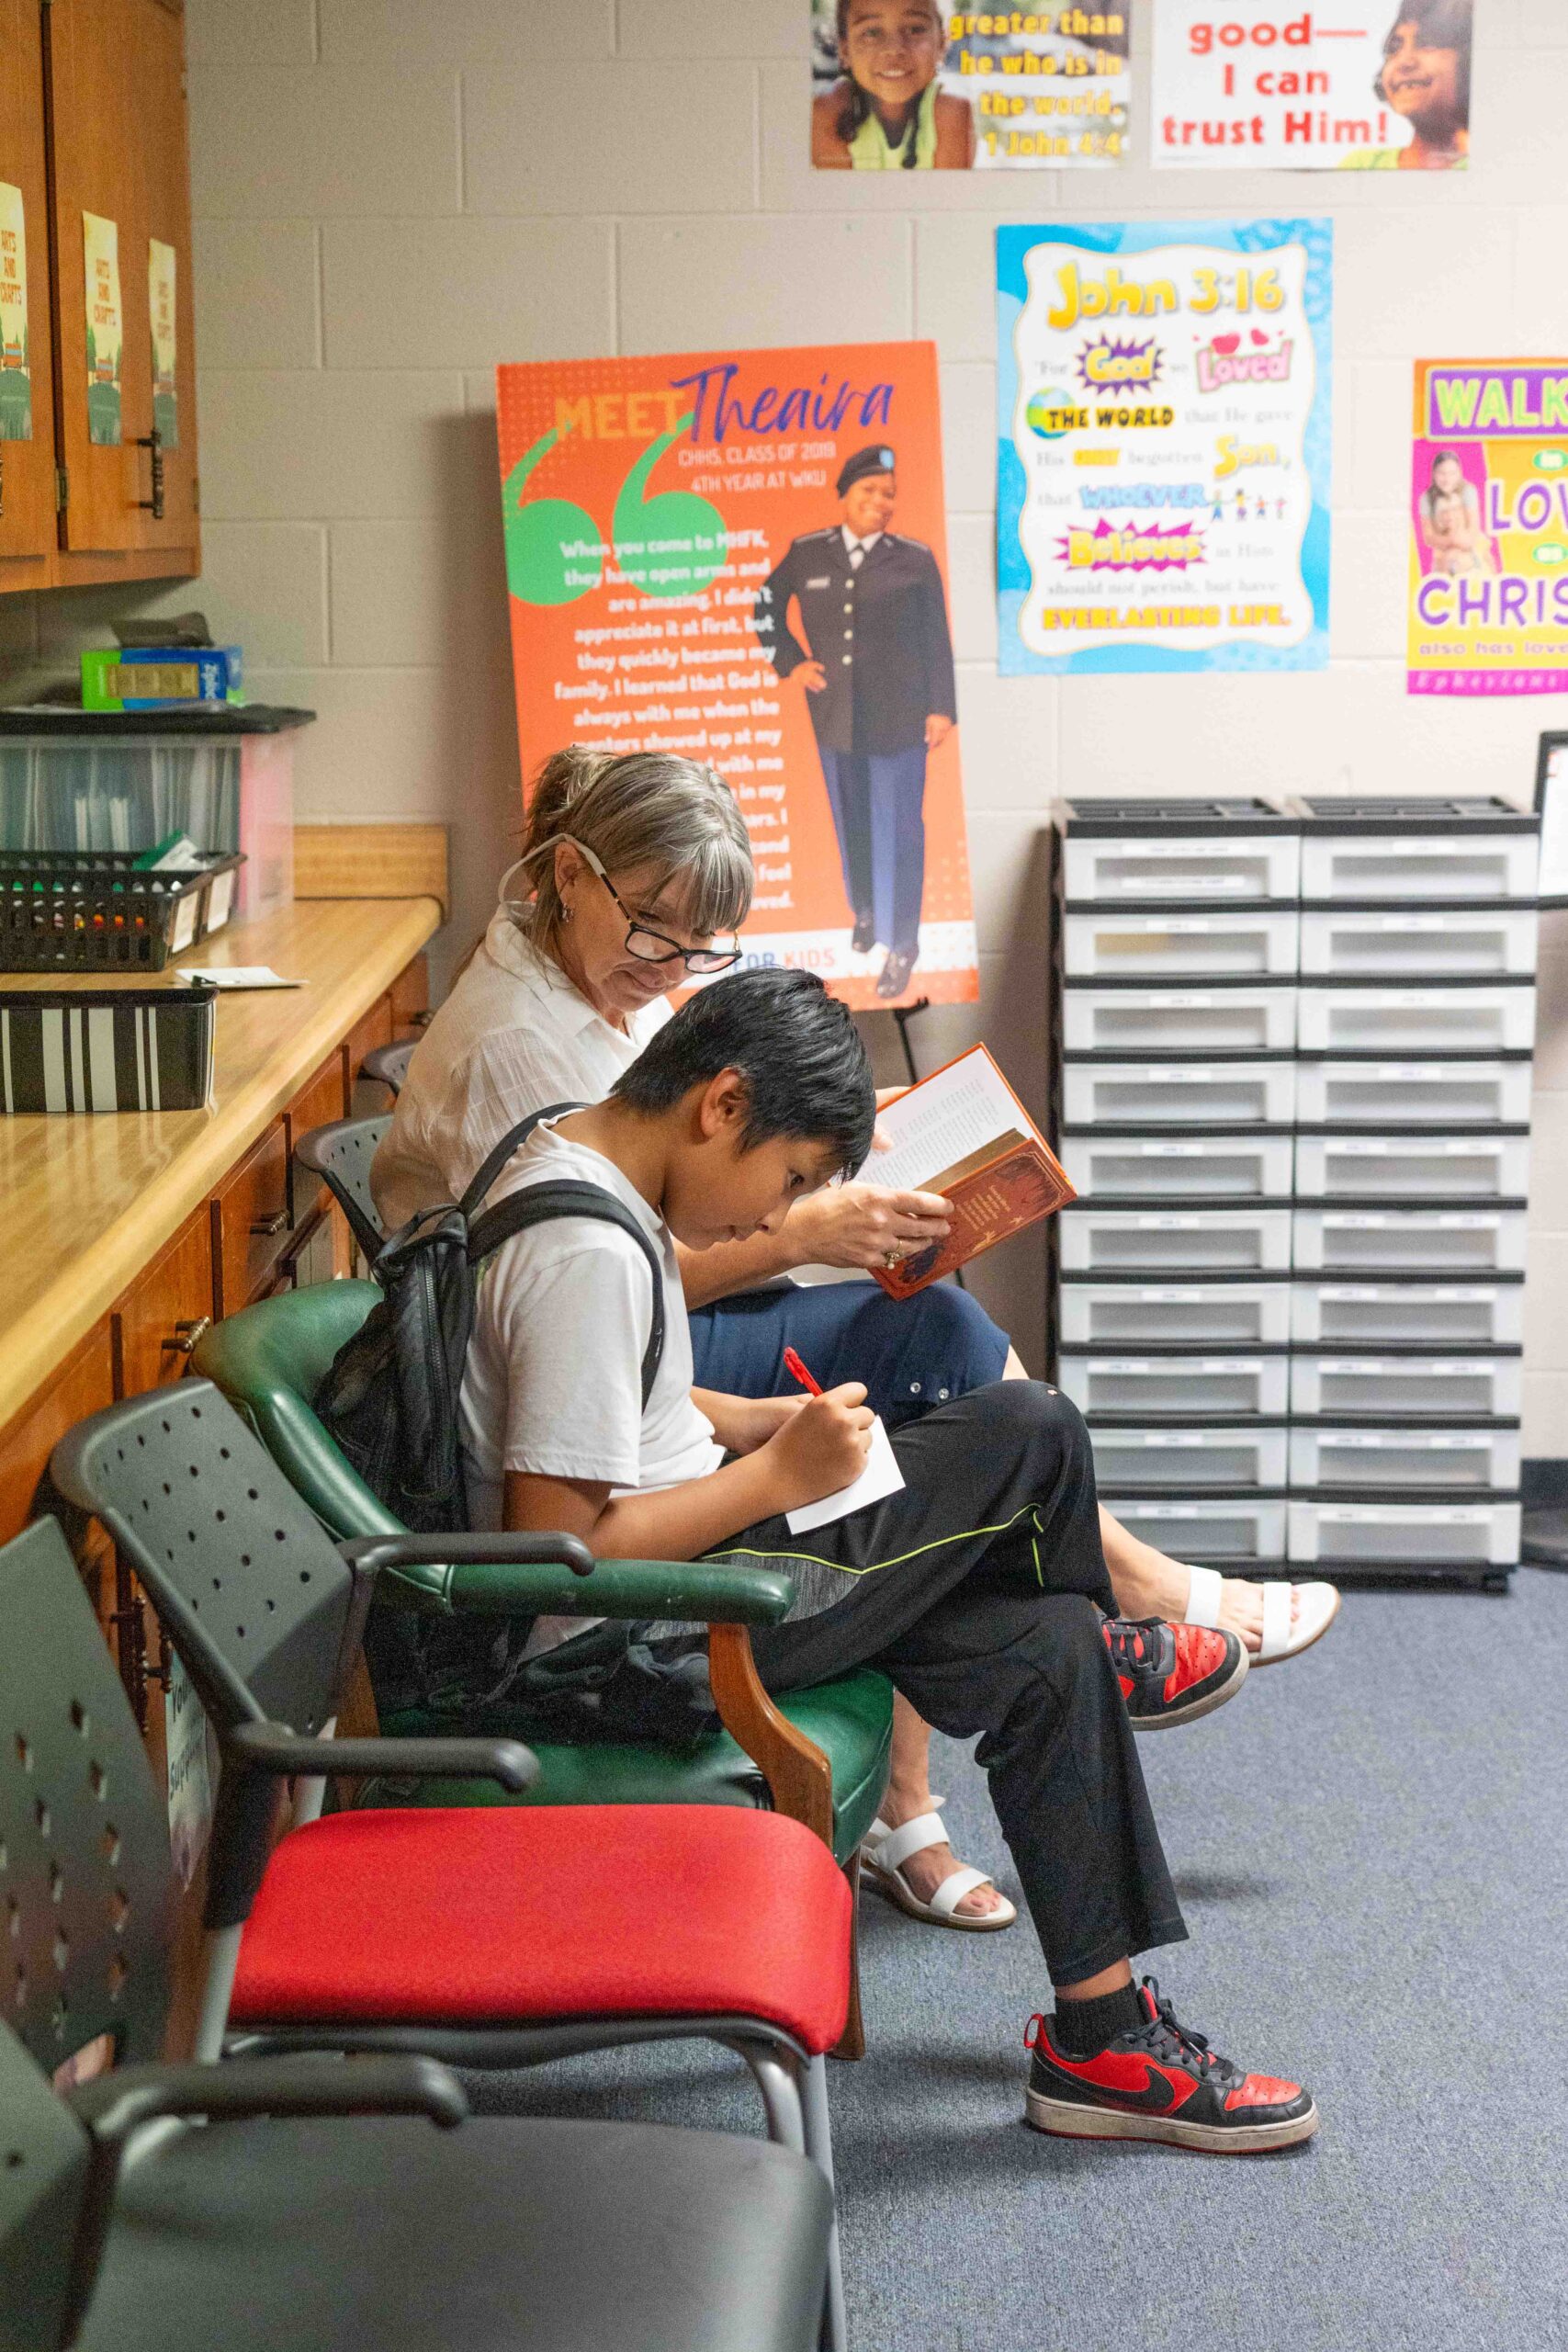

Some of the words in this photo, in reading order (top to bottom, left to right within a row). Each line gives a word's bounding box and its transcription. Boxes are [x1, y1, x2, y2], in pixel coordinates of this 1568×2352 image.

[948, 11, 1052, 40] greater
[1060, 9, 1123, 35] than
[960, 50, 992, 75] he
[1000, 50, 1055, 75] who
[1066, 50, 1089, 75] is
[1096, 50, 1122, 75] in
[1224, 63, 1235, 96] I
[1254, 70, 1329, 96] can
[980, 91, 1025, 116] the
[1033, 90, 1122, 116] world.
[1162, 115, 1264, 145] trust
[1284, 111, 1388, 144] Him!
[985, 132, 998, 157] 1
[1007, 132, 1069, 157] John
[1077, 132, 1121, 157] 4:4
[1046, 260, 1179, 331] John
[1190, 266, 1286, 314] 3:16
[1084, 344, 1158, 383] God
[1195, 338, 1296, 394] Loved
[554, 390, 685, 441] MEET
[671, 363, 896, 443] Theaira
[1434, 378, 1568, 429] WALK
[1046, 406, 1089, 430] THE
[1097, 405, 1175, 430] WORLD
[726, 444, 775, 465] CLASS
[777, 443, 797, 461] OF
[691, 475, 721, 492] 4TH
[723, 472, 765, 492] YEAR
[766, 470, 785, 488] AT
[559, 538, 611, 559] When
[614, 542, 644, 560] you
[695, 535, 714, 551] to
[1068, 529, 1204, 568] Believes
[605, 568, 646, 584] have
[739, 558, 771, 576] and
[1417, 577, 1568, 628] CHRIS
[1043, 604, 1221, 630] EVERLASTING
[1418, 640, 1467, 656] also
[1474, 640, 1515, 656] has
[577, 651, 615, 673] they
[690, 672, 726, 691] that
[784, 946, 836, 969] KIDS
